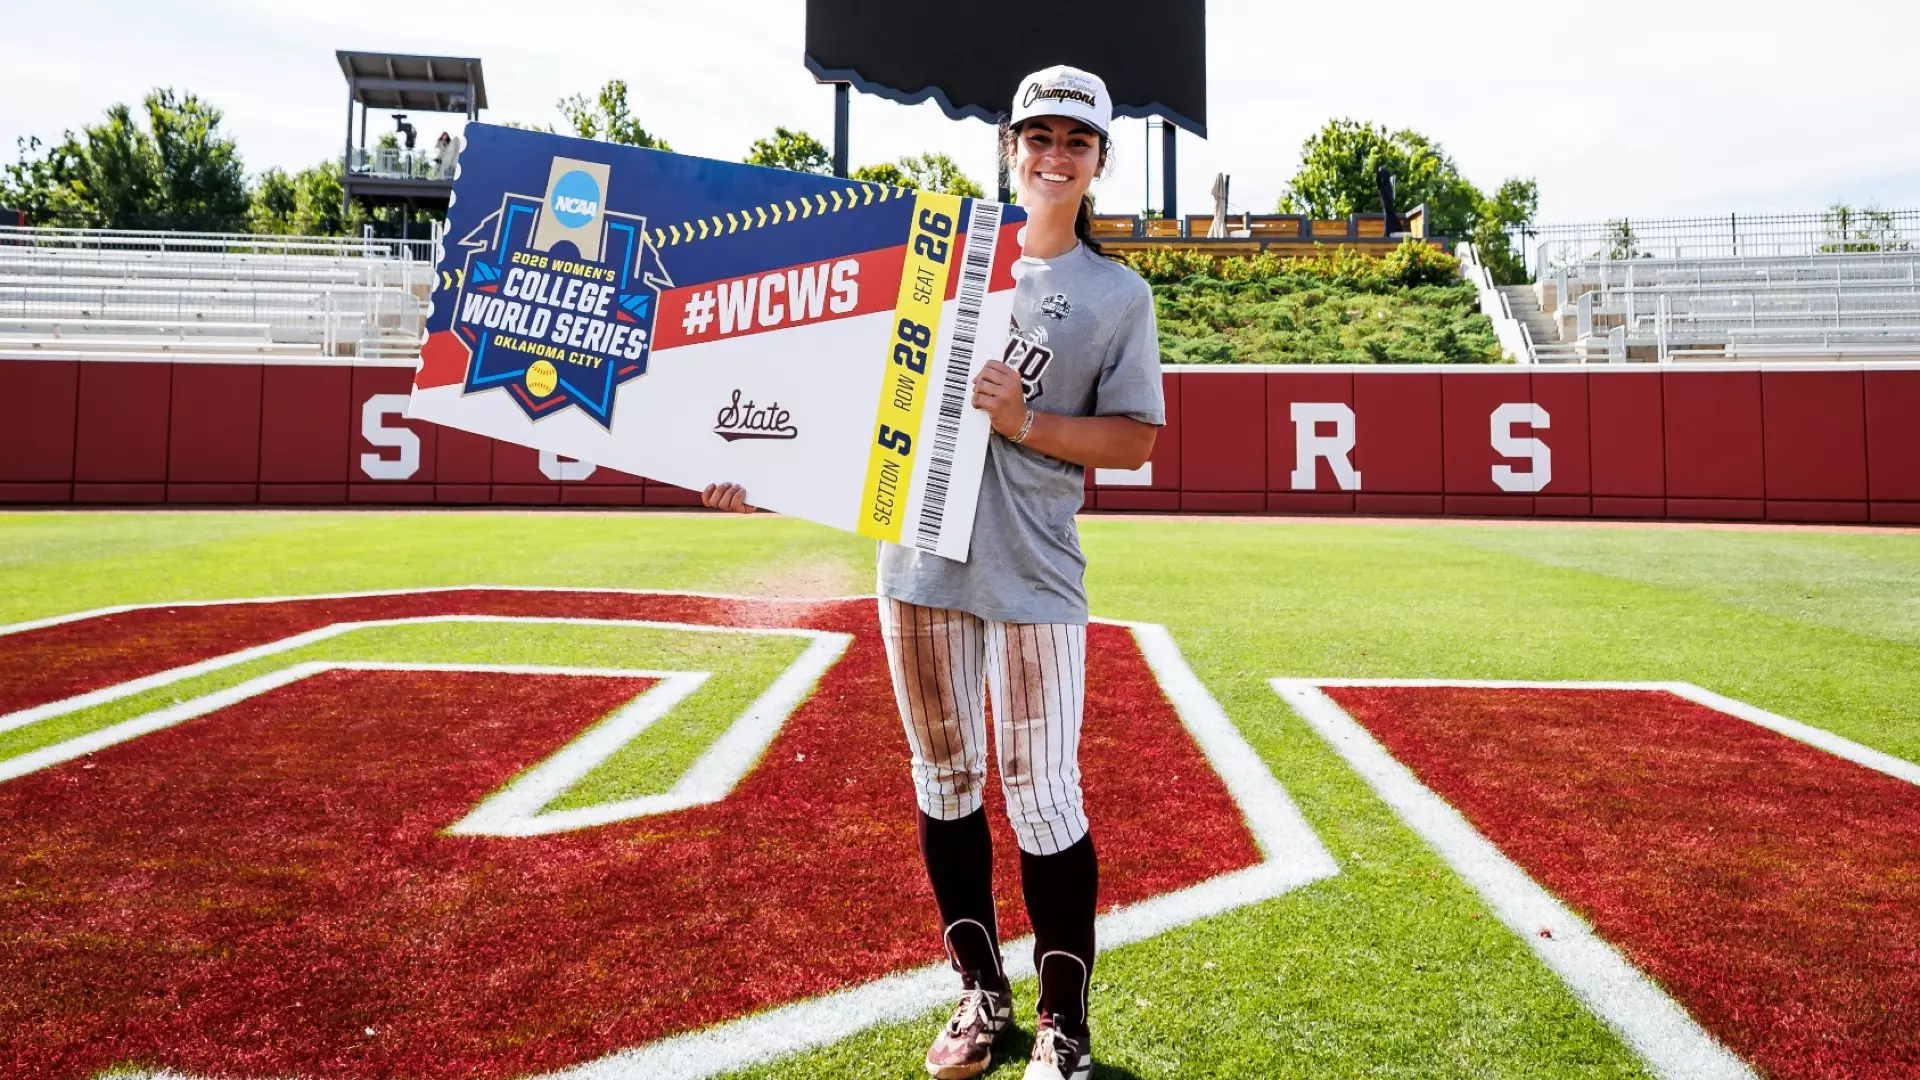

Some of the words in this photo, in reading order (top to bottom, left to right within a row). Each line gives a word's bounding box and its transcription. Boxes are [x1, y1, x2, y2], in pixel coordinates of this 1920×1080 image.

[1023, 82, 1096, 108] Champions
[555, 195, 598, 217] NCAA
[914, 209, 953, 265] 26
[511, 252, 549, 269] 2026
[551, 259, 616, 282] WOMEN'S
[913, 265, 936, 304] SEAT
[503, 267, 615, 317] COLLEGE
[681, 258, 860, 335] #WCWS
[461, 293, 552, 338] WORLD
[551, 313, 647, 360] SERIES
[893, 318, 931, 375] 28
[494, 335, 565, 361] OKLAHOMA
[568, 351, 603, 369] CITY
[713, 389, 797, 441] State
[893, 374, 916, 413] ROW
[878, 424, 912, 457] 5
[873, 459, 900, 526] SECTION
